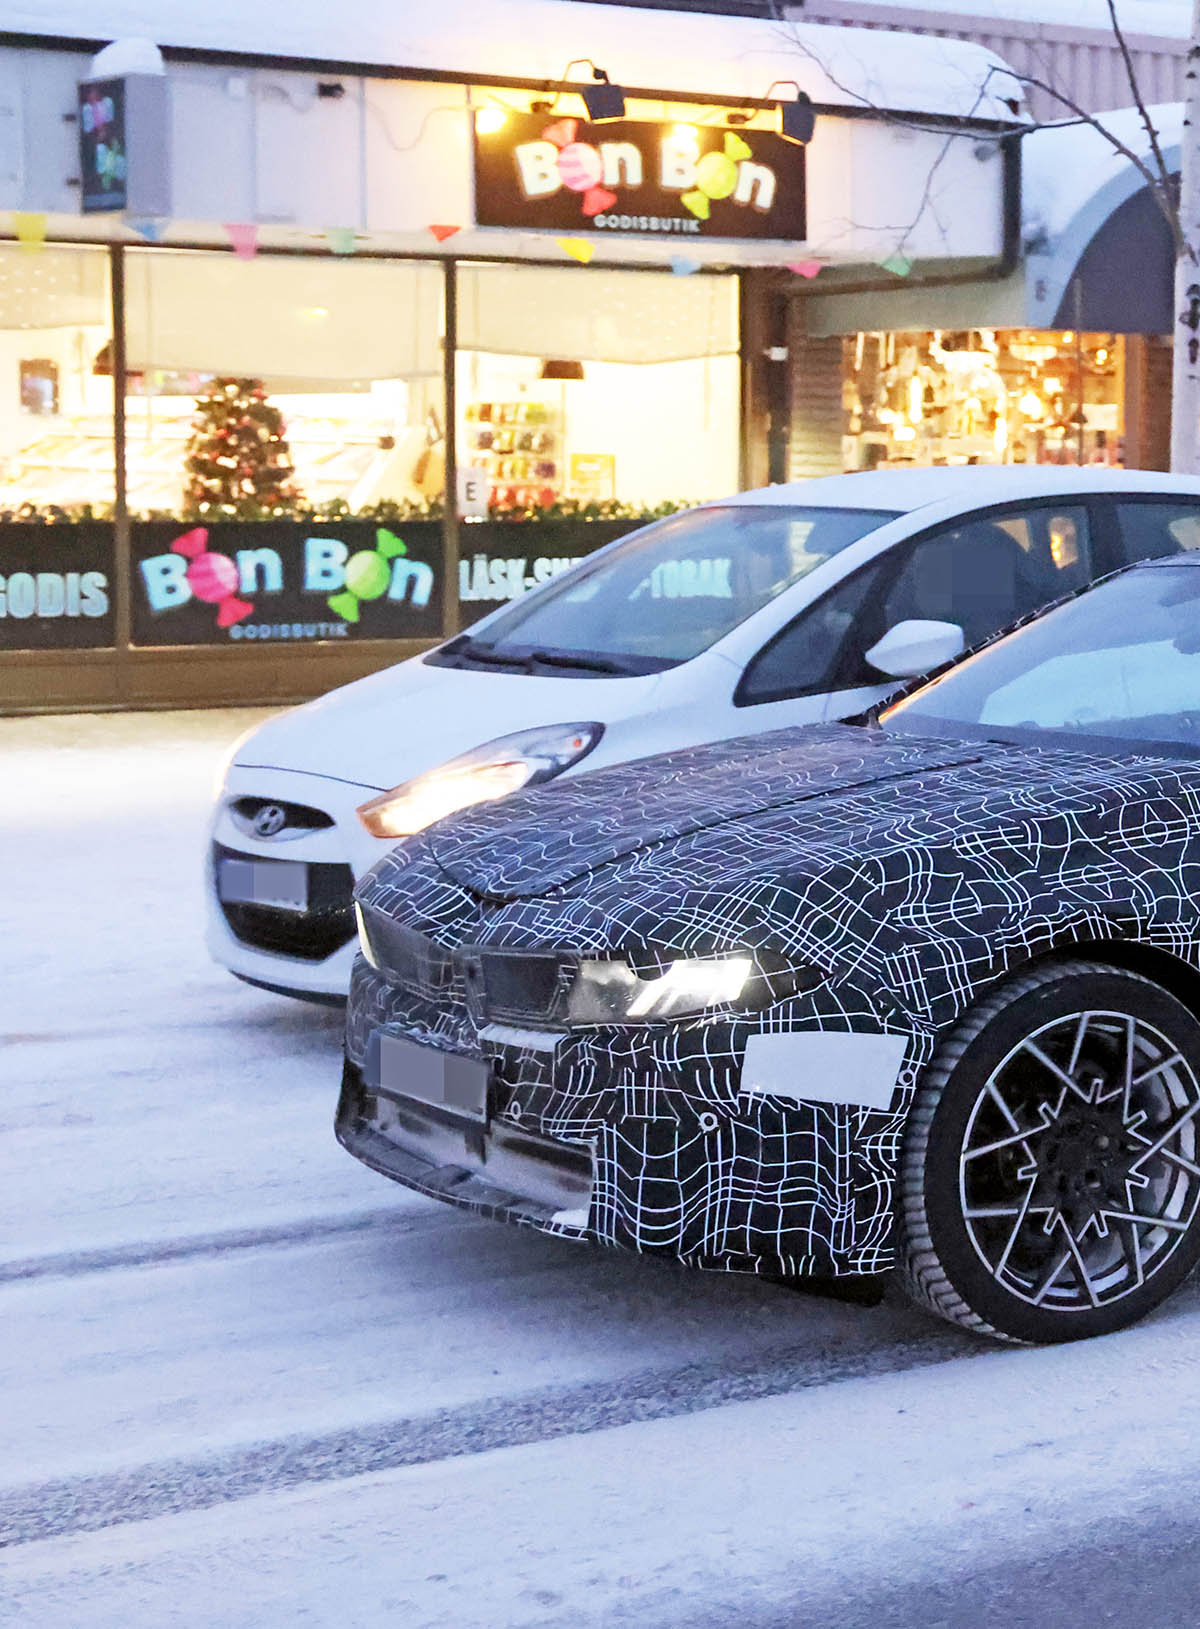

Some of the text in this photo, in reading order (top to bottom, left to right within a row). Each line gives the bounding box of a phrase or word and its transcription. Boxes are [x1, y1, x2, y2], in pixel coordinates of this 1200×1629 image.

[594, 213, 701, 233] GODISBUTIK
[0, 571, 109, 619] ODIS
[229, 622, 349, 641] GODISBUTIK
